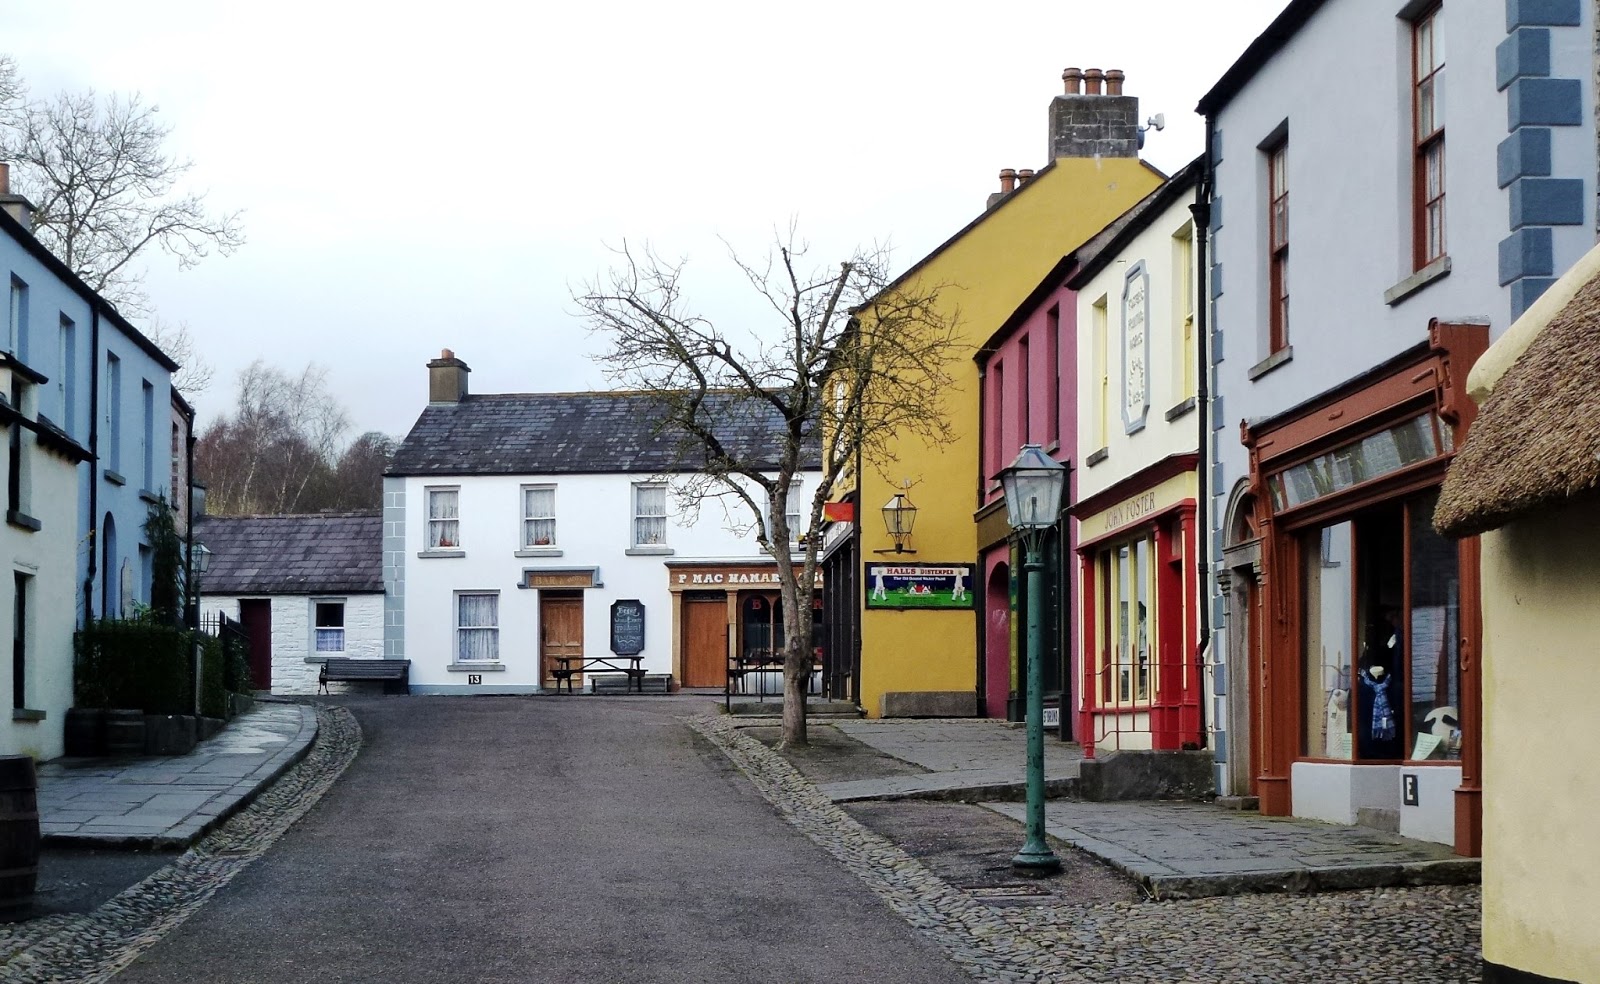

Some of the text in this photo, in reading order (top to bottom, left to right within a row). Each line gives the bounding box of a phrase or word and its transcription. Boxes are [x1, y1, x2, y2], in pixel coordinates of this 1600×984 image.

[1105, 492, 1155, 530] JOHN FOSTER
[679, 574, 687, 583] P
[693, 574, 723, 583] MAC
[470, 675, 480, 684] 13
[1406, 777, 1414, 800] E
